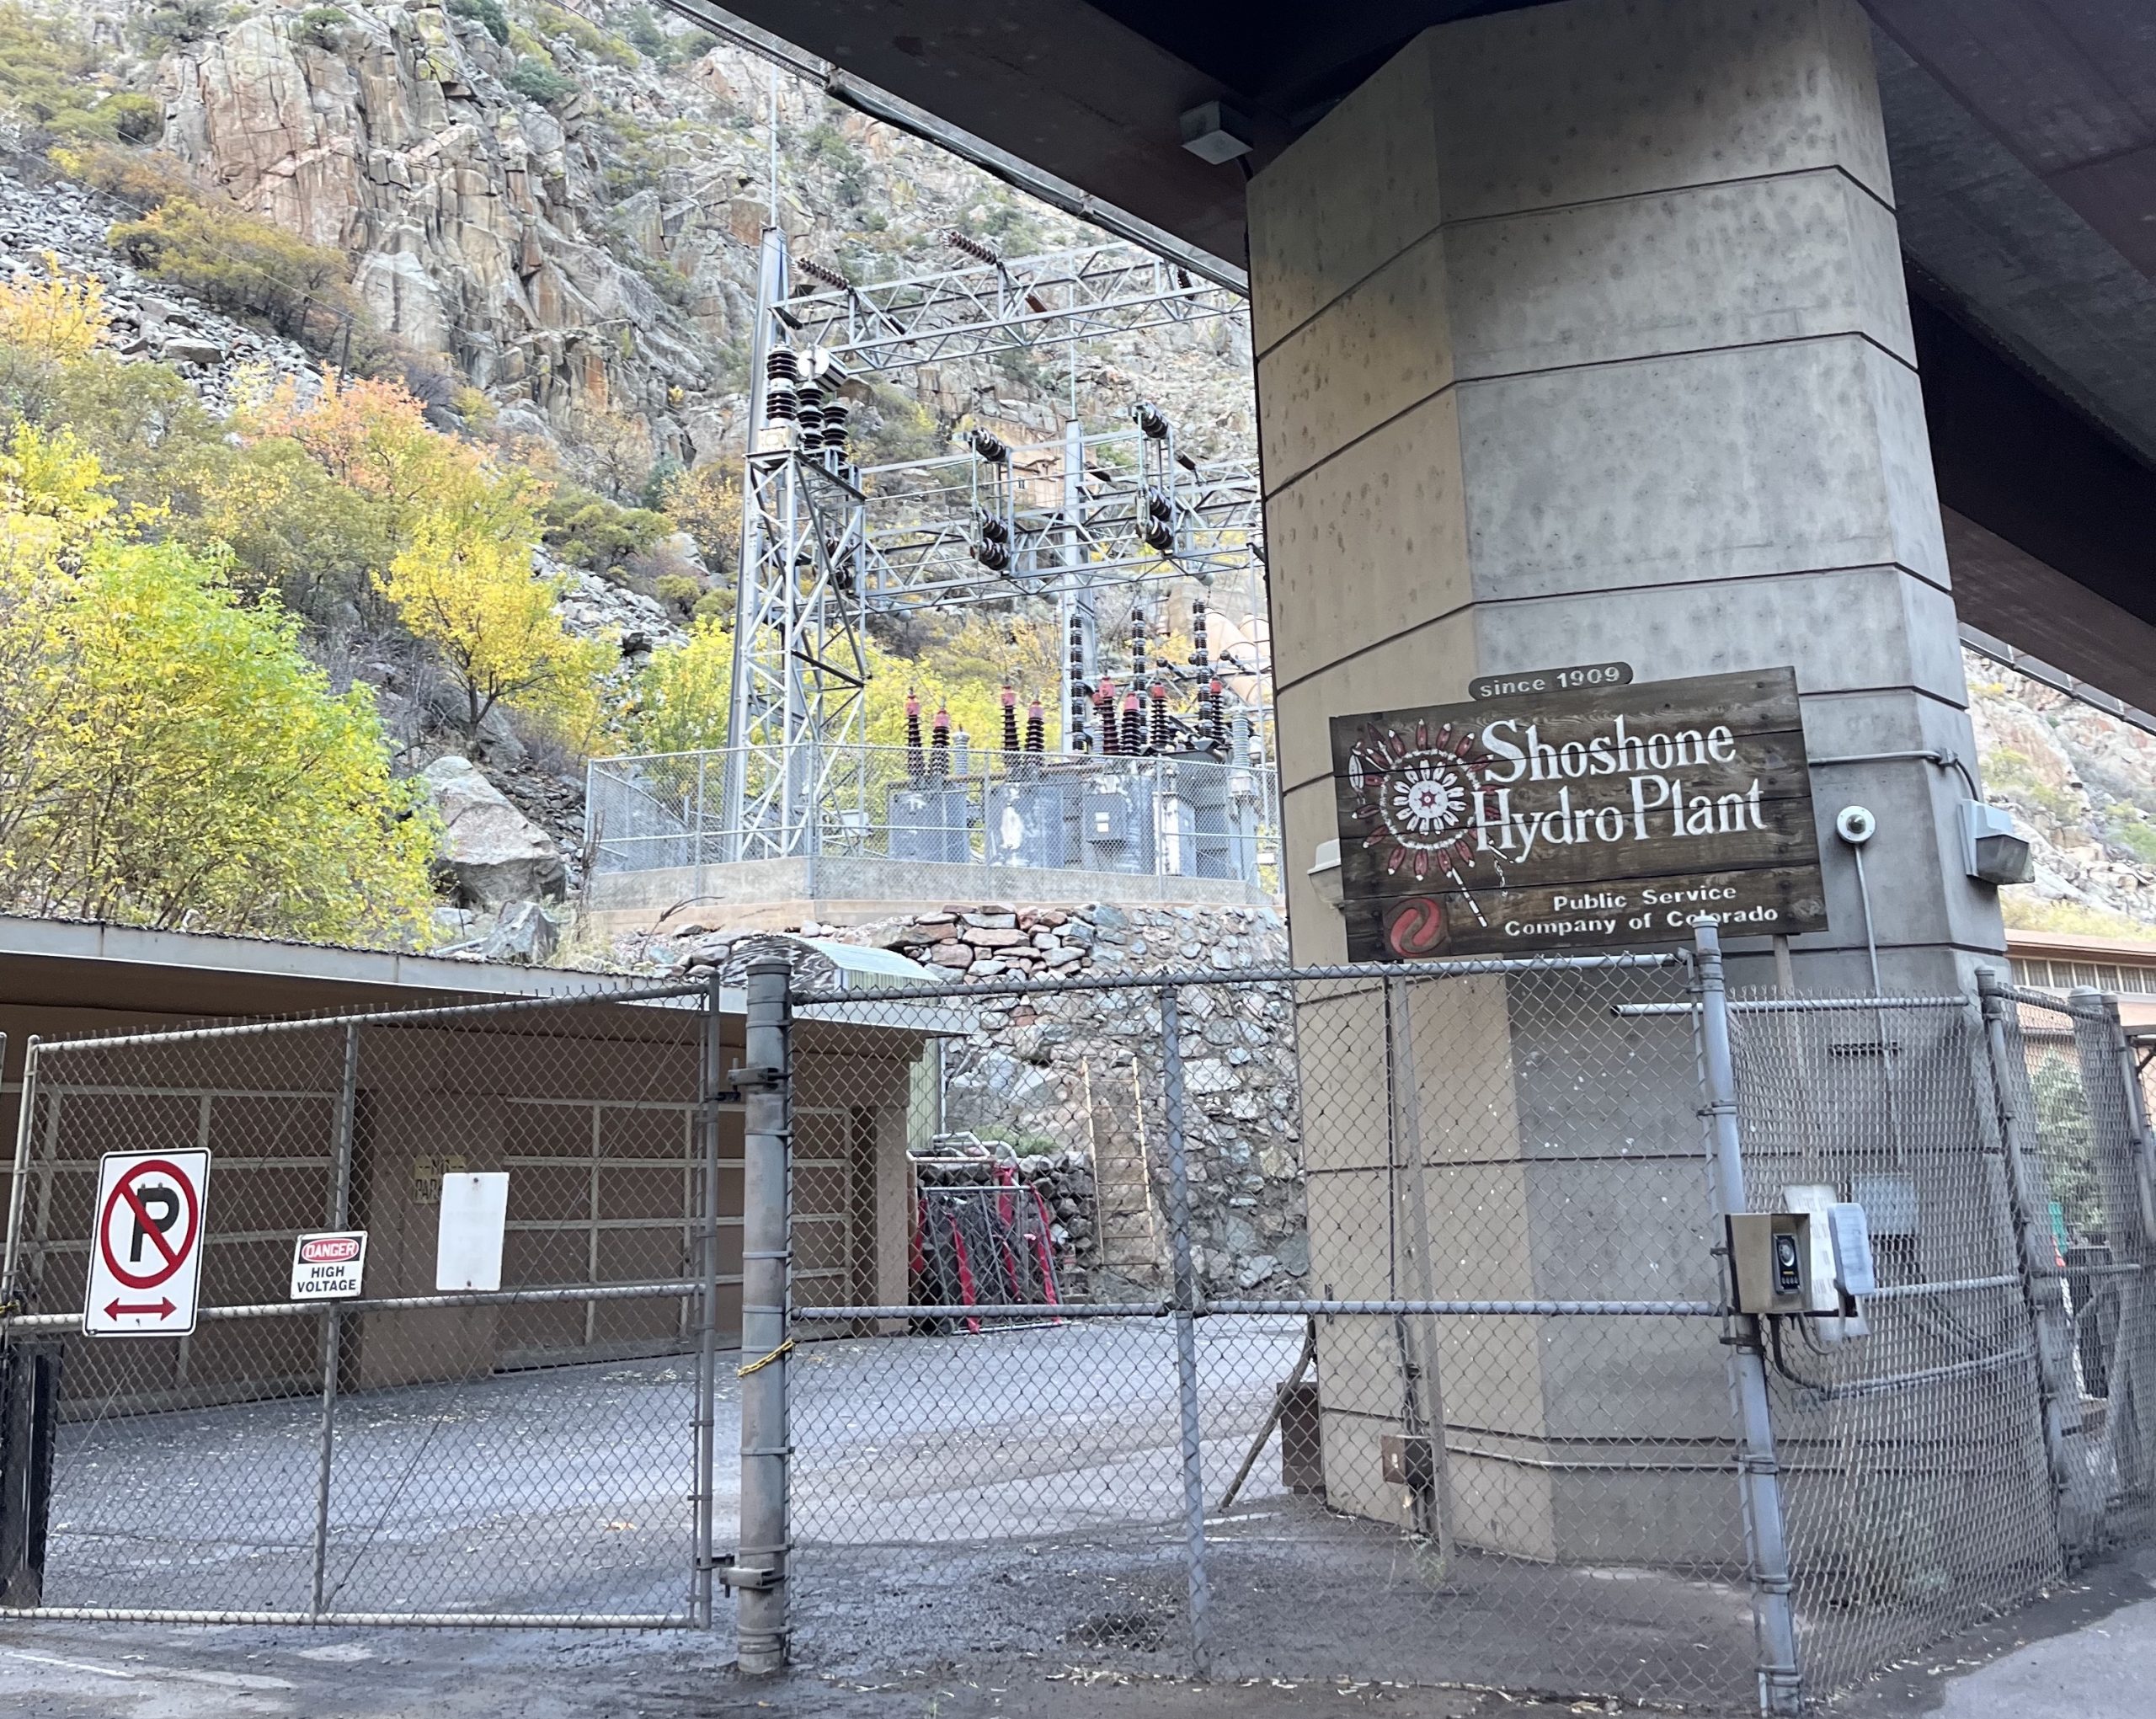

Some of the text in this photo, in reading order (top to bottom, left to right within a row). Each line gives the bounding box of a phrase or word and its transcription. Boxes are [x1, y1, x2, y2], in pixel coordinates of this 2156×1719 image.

[1479, 666, 1620, 697] since 1909
[1481, 713, 1737, 783] Shoshone
[1629, 774, 1769, 841] Plant
[1553, 885, 1737, 912] Public Service
[1504, 918, 1617, 937] Company
[1629, 913, 1653, 931] of
[305, 1241, 356, 1258] DANGER
[311, 1266, 345, 1279] HIGH
[297, 1279, 357, 1293] VOLTAGE
